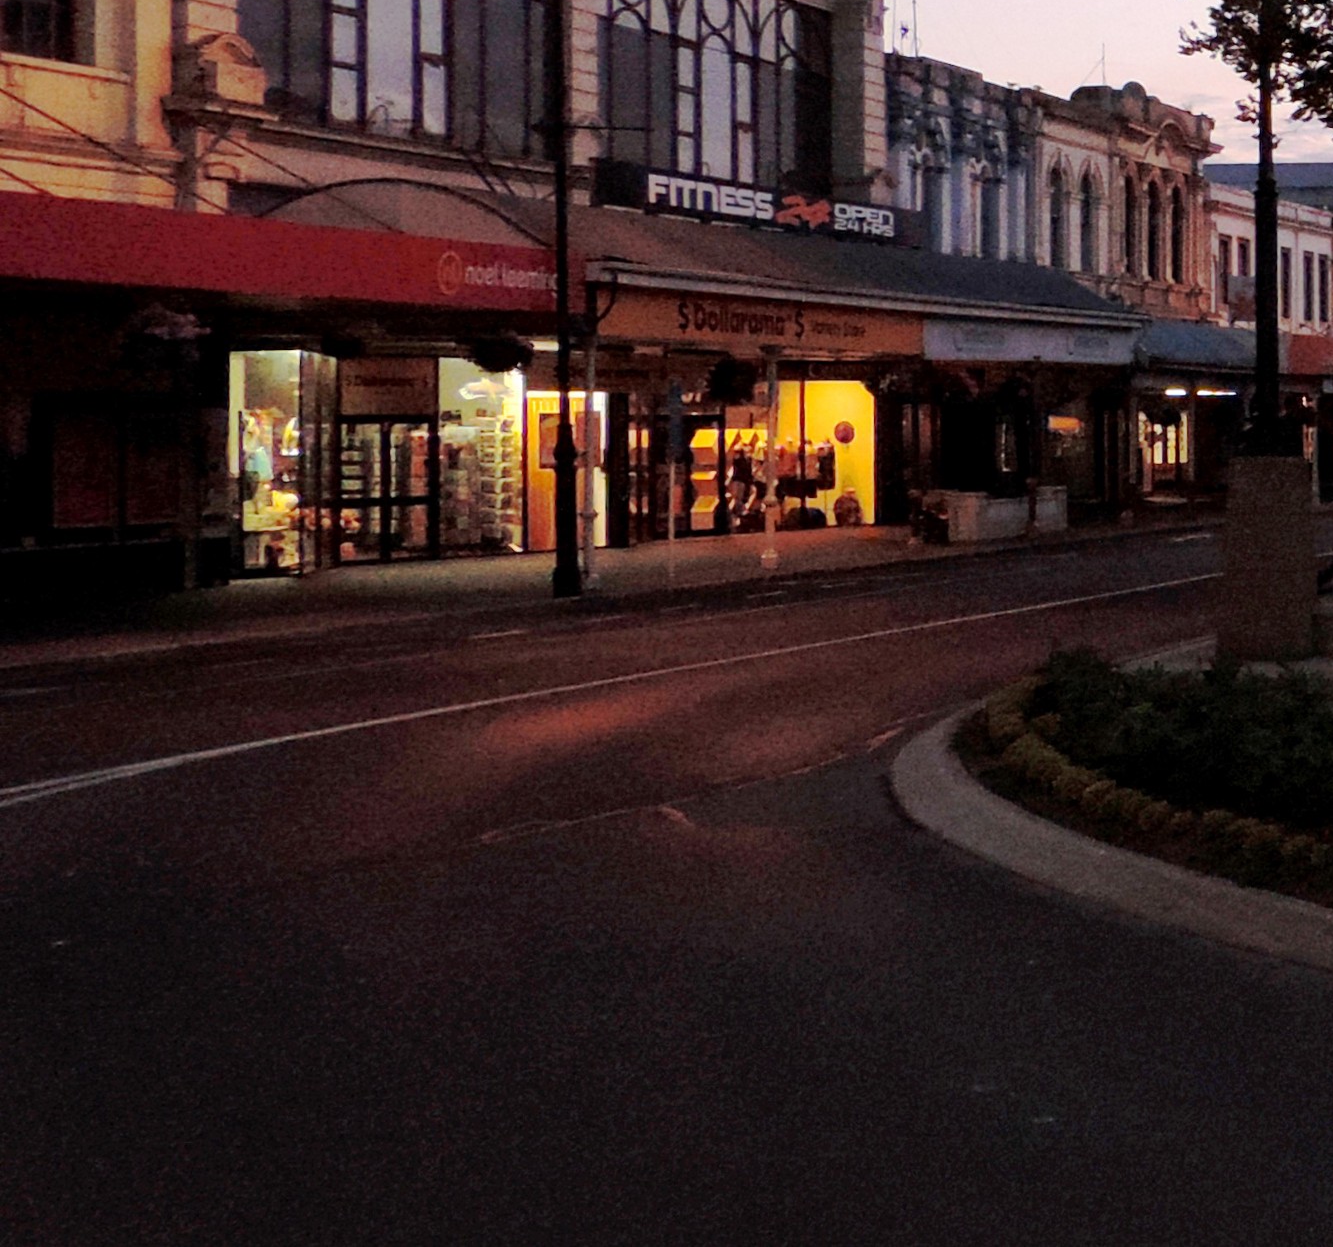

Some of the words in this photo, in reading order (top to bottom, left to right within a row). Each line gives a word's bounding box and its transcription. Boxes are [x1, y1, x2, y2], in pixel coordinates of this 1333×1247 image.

[648, 173, 773, 220] FITNESS
[834, 203, 894, 225] OPEN
[834, 218, 860, 232] 24
[862, 221, 895, 238] HRS
[678, 301, 689, 334] $
[794, 309, 805, 341] $
